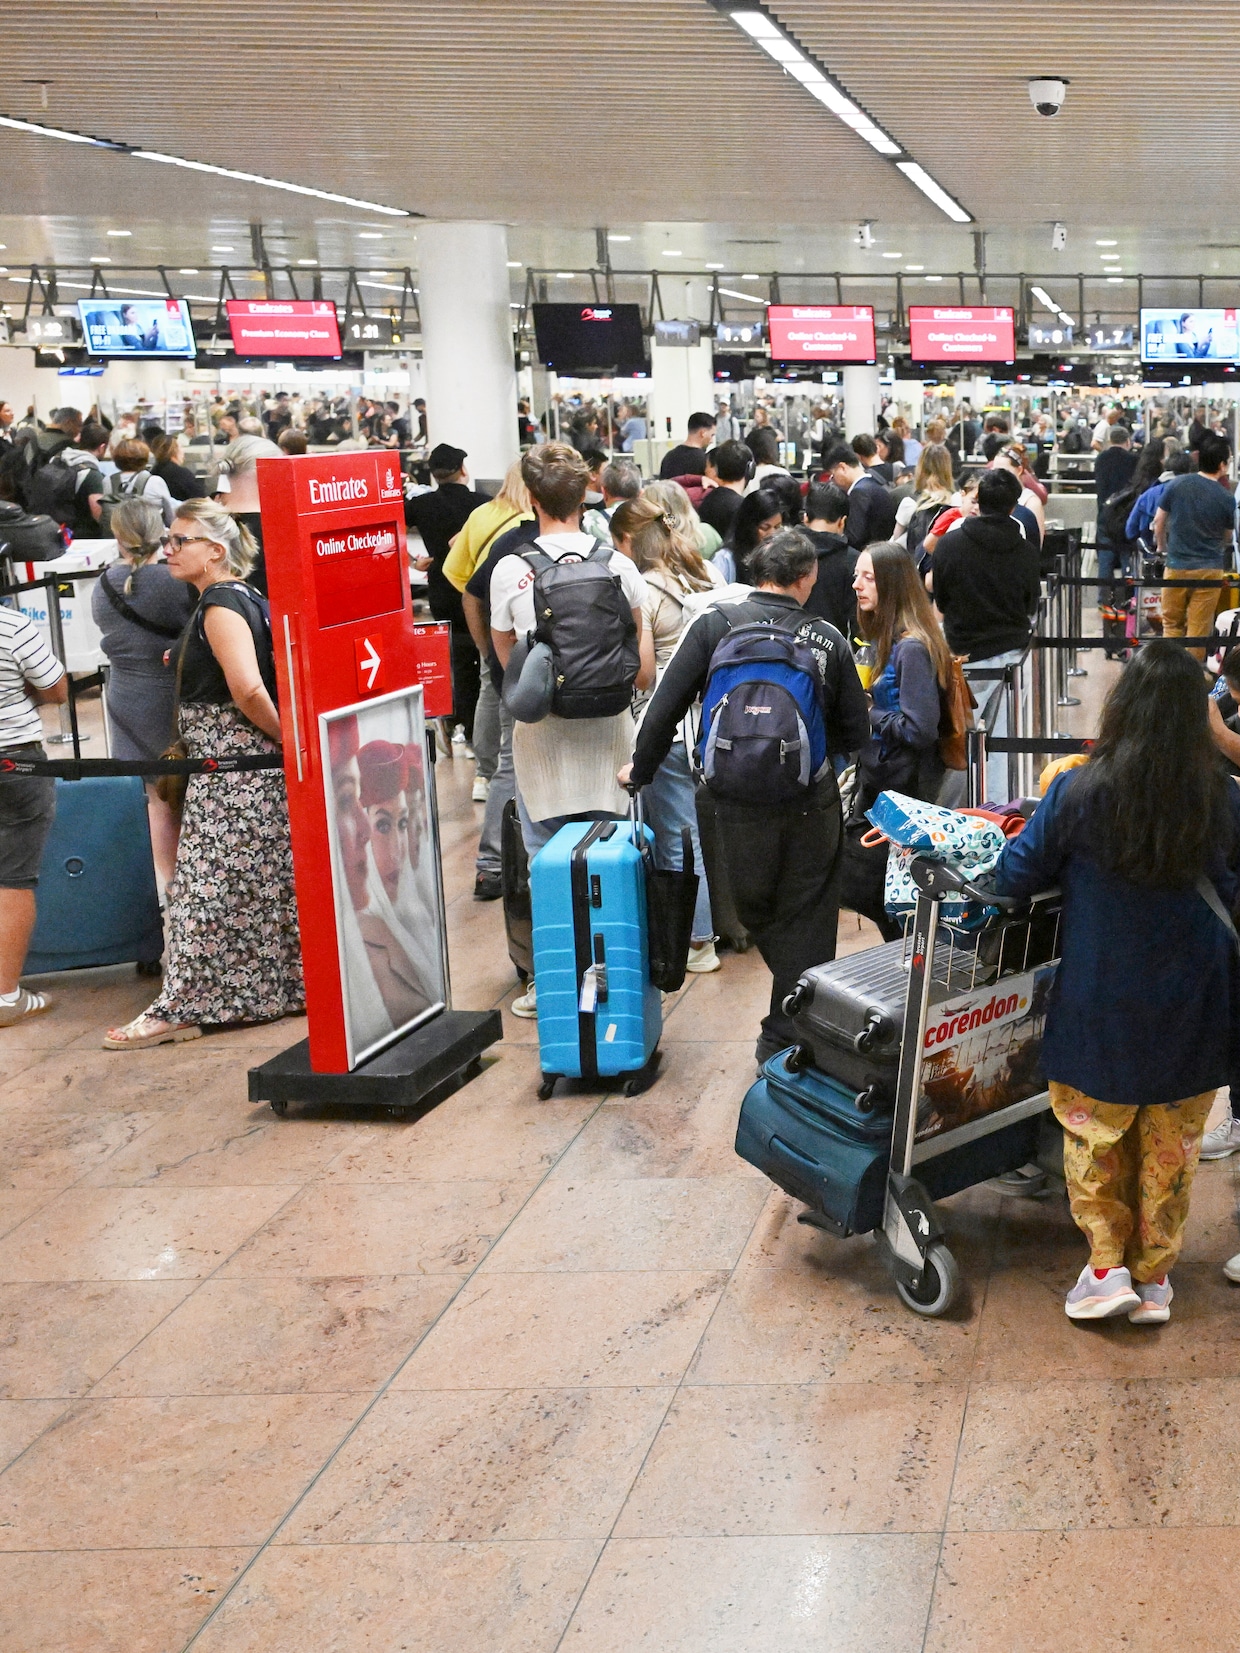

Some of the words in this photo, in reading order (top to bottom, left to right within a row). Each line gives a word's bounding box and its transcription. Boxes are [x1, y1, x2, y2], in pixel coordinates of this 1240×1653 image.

[248, 303, 293, 313] Emirates
[792, 308, 832, 318] Emirates
[933, 309, 973, 319] Emirates
[241, 330, 274, 338] Premium
[275, 330, 309, 339] Economy
[310, 330, 329, 338] Class
[787, 332, 814, 341] Online
[928, 333, 953, 342] Online
[802, 342, 843, 351] Customers
[942, 343, 983, 352] Customers
[308, 475, 368, 504] Emirates
[381, 488, 402, 499] Emirates
[316, 537, 346, 557] Online
[347, 529, 393, 553] Checked-in
